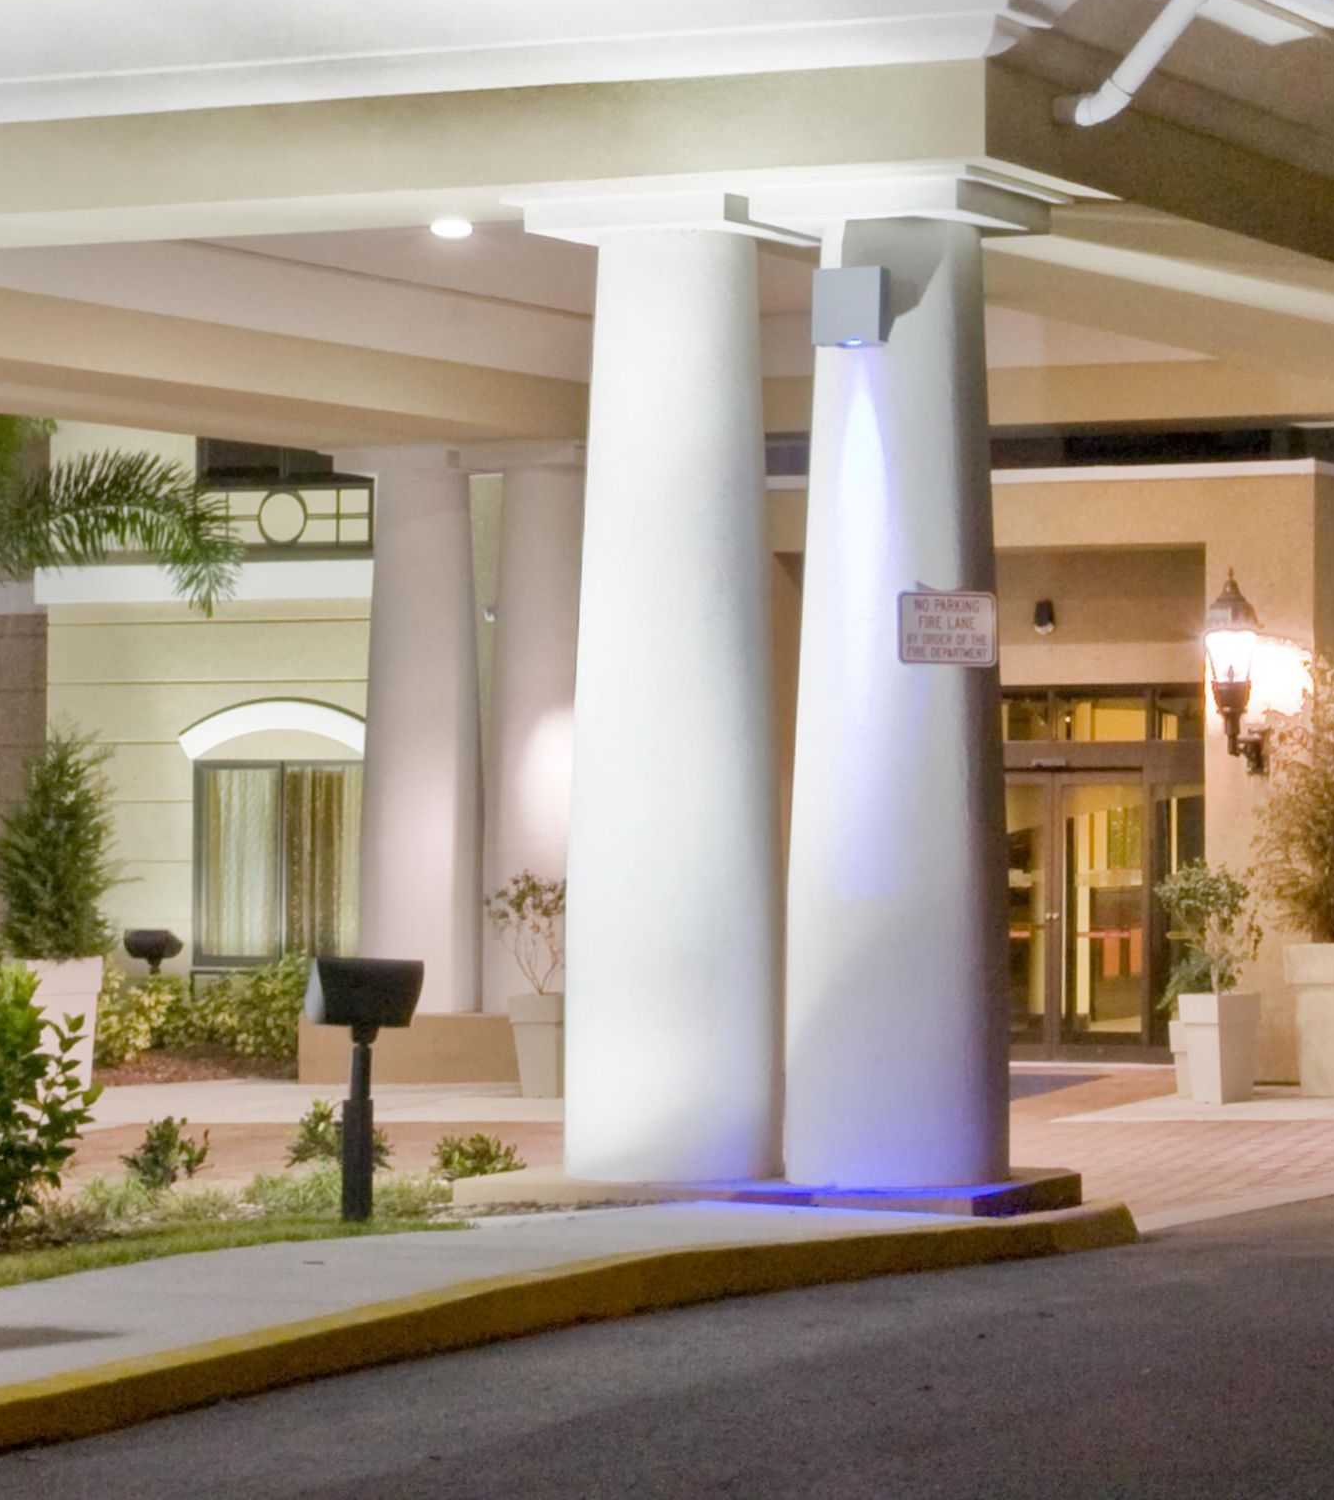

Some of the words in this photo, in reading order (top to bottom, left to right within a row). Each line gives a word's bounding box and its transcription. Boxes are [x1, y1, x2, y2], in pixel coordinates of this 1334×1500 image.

[914, 598, 929, 612] NO
[934, 599, 980, 613] PARKING
[918, 615, 942, 629] FIRE
[947, 616, 976, 630] LANE
[906, 633, 918, 644] BY
[922, 633, 952, 645] ORDER
[956, 634, 966, 645] OF
[971, 634, 987, 646] THE
[907, 645, 926, 657] FIRE
[930, 646, 988, 659] DEPARTMENT
